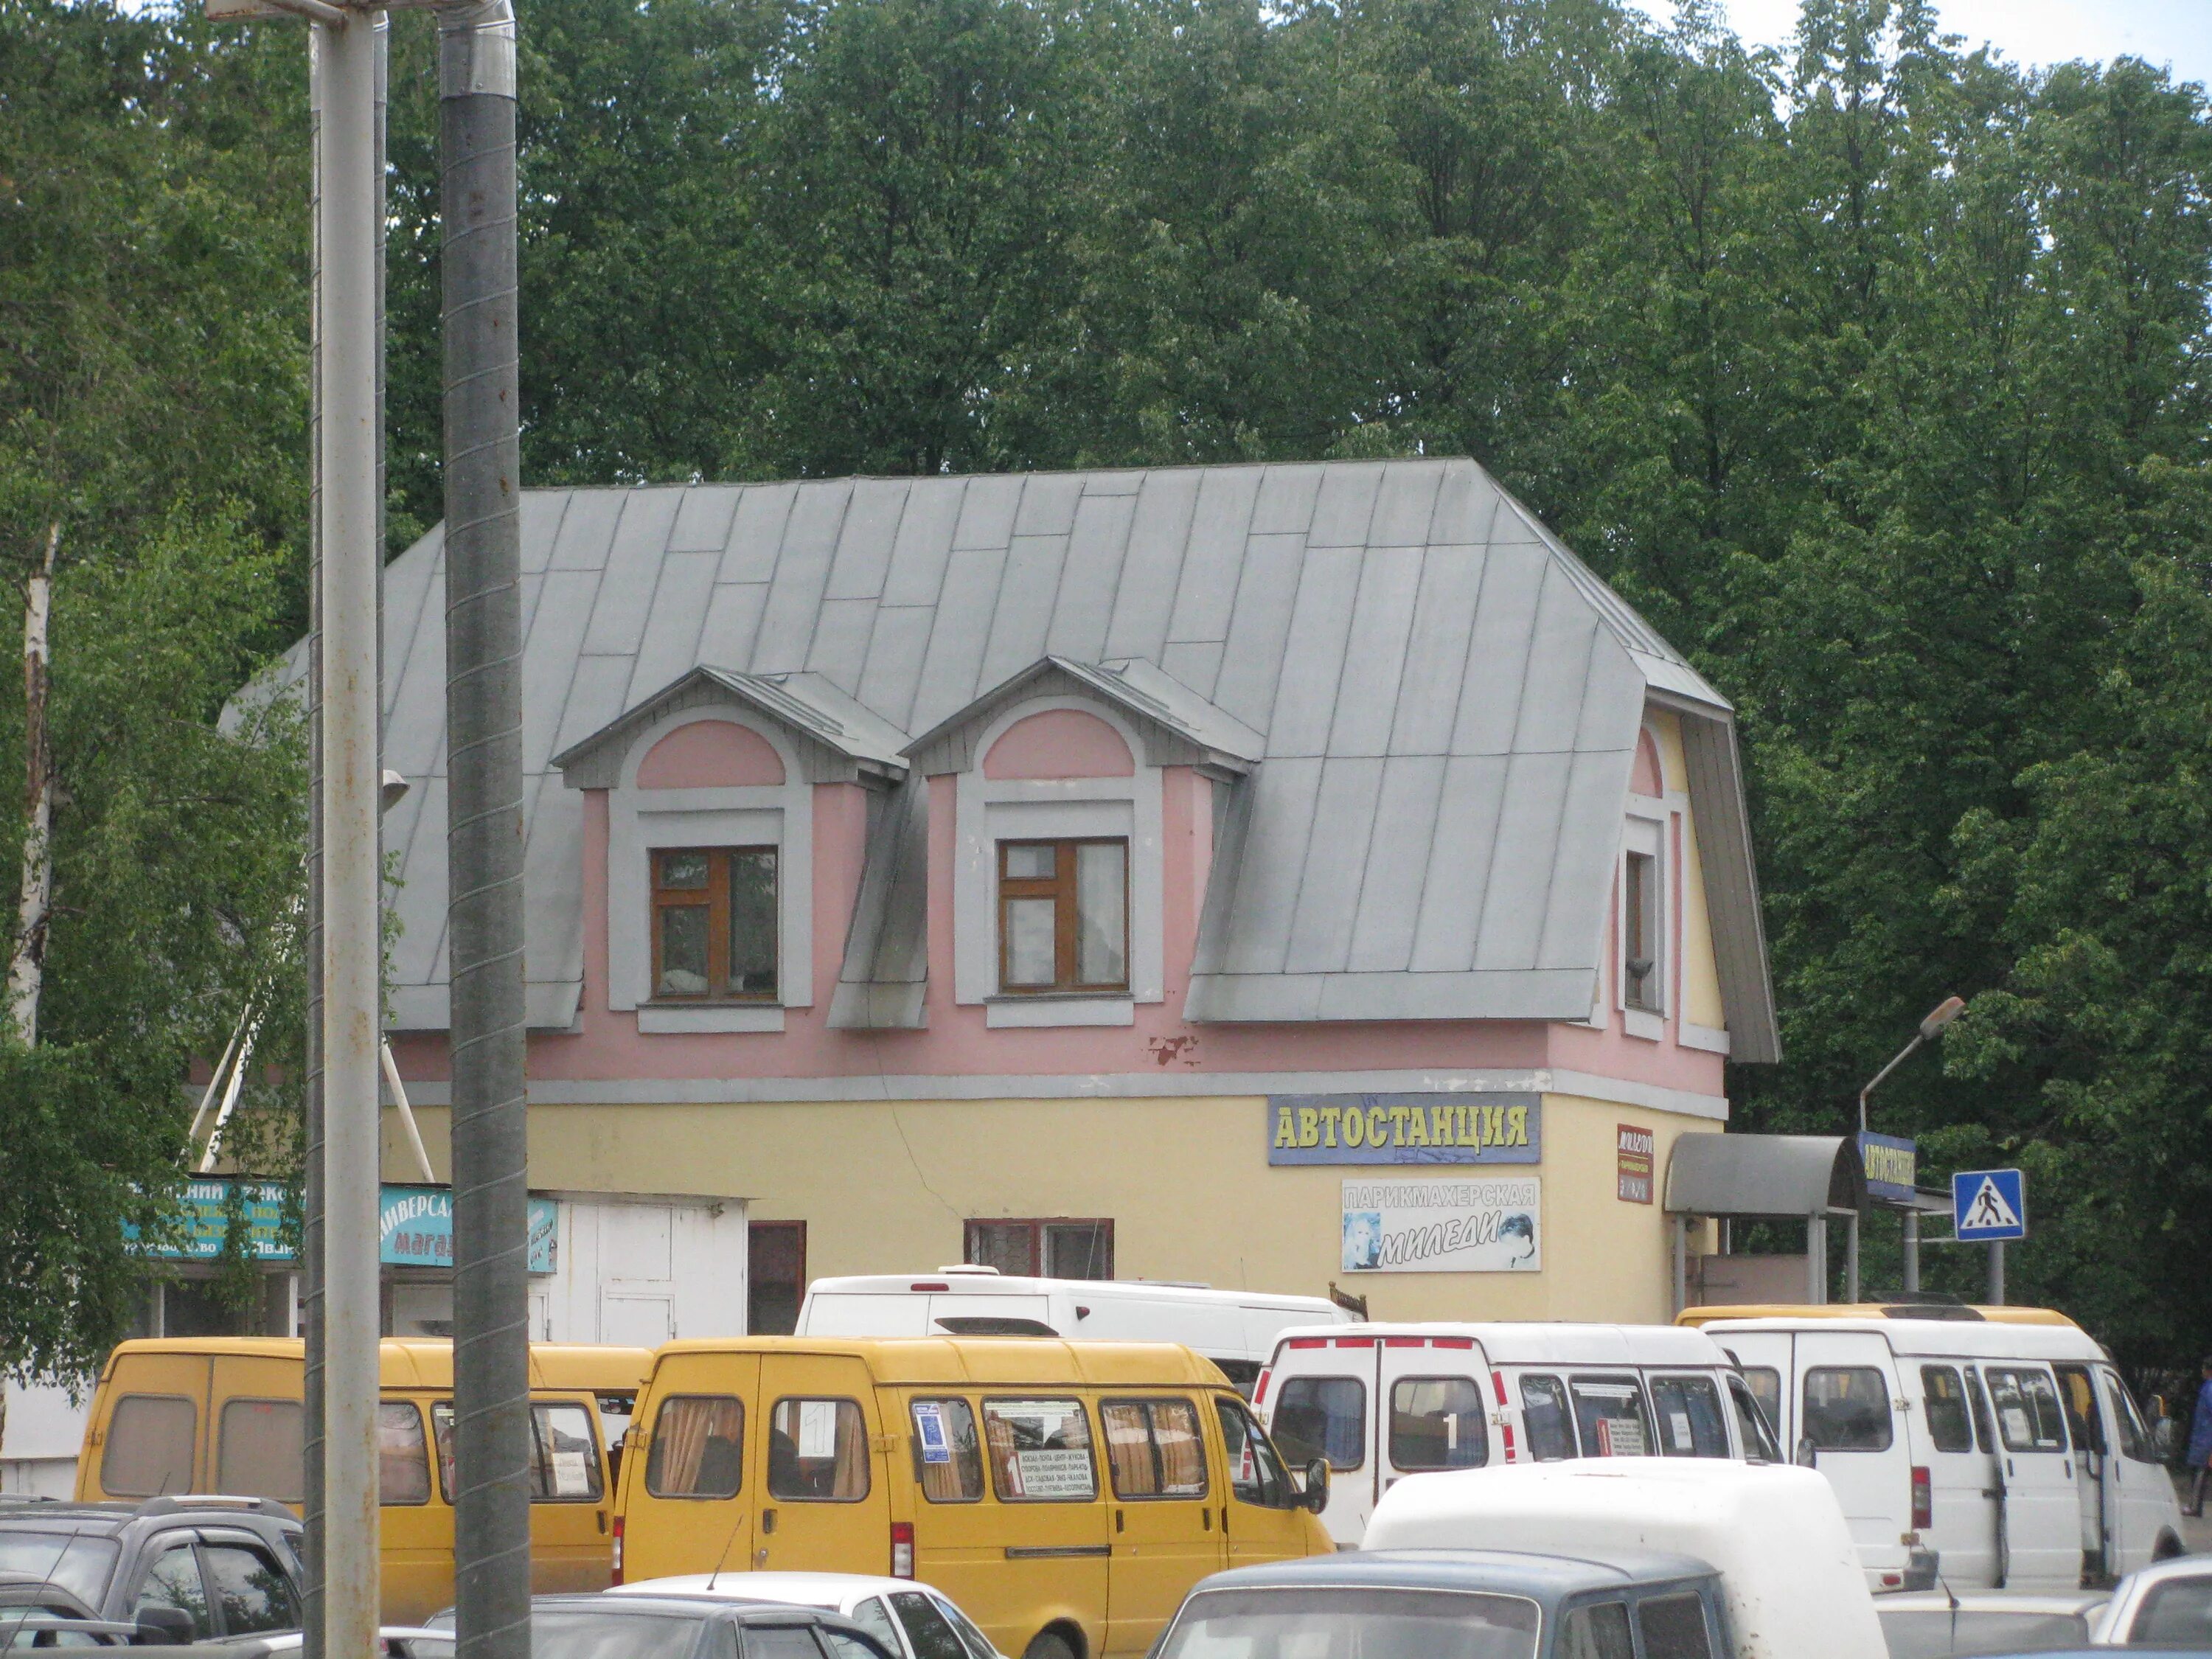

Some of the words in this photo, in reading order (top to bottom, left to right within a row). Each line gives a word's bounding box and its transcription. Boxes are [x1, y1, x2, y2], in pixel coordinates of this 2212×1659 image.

[1274, 1105, 1530, 1156] АВТОСТАНЦИЯ
[1343, 1183, 1536, 1208] ПАРИКМАХЕРСКАЯ
[1377, 1210, 1502, 1268] МИЛЕДИ
[804, 1404, 827, 1453] 1
[1443, 1413, 1457, 1450] 1
[1007, 1455, 1023, 1494] 1
